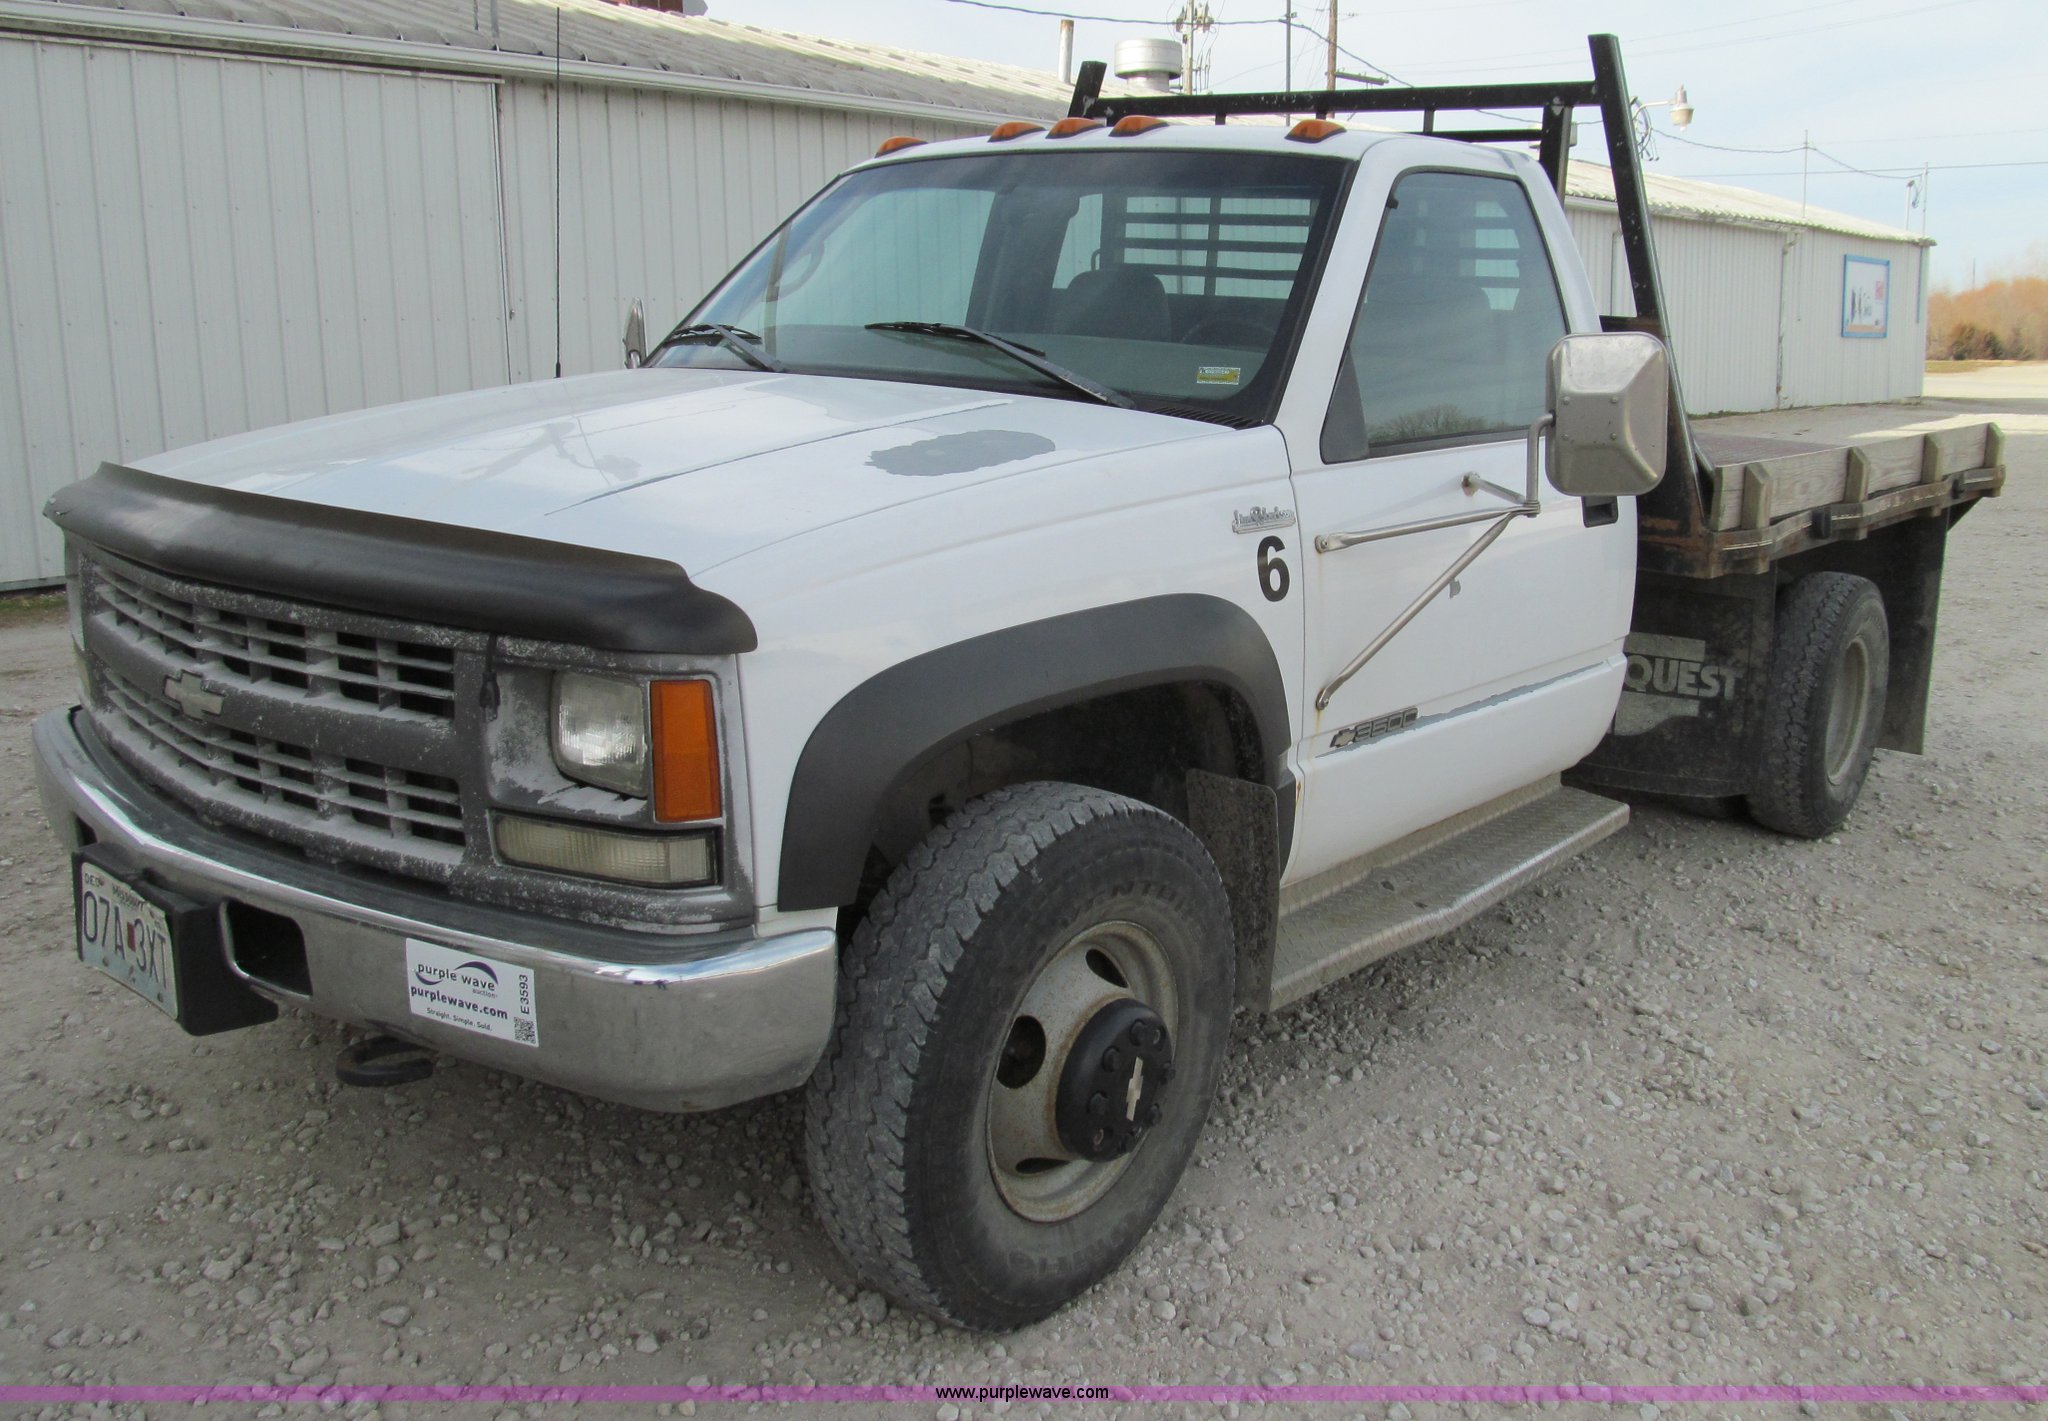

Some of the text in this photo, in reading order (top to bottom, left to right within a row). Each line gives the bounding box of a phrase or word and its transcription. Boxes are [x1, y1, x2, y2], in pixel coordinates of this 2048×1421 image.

[1257, 535, 1291, 602] 6
[1624, 654, 1744, 701] QUEST
[418, 963, 496, 991] purple wave
[519, 974, 530, 1015] E3593
[411, 986, 508, 1020] purplewave.com
[426, 1007, 451, 1020] Straight.
